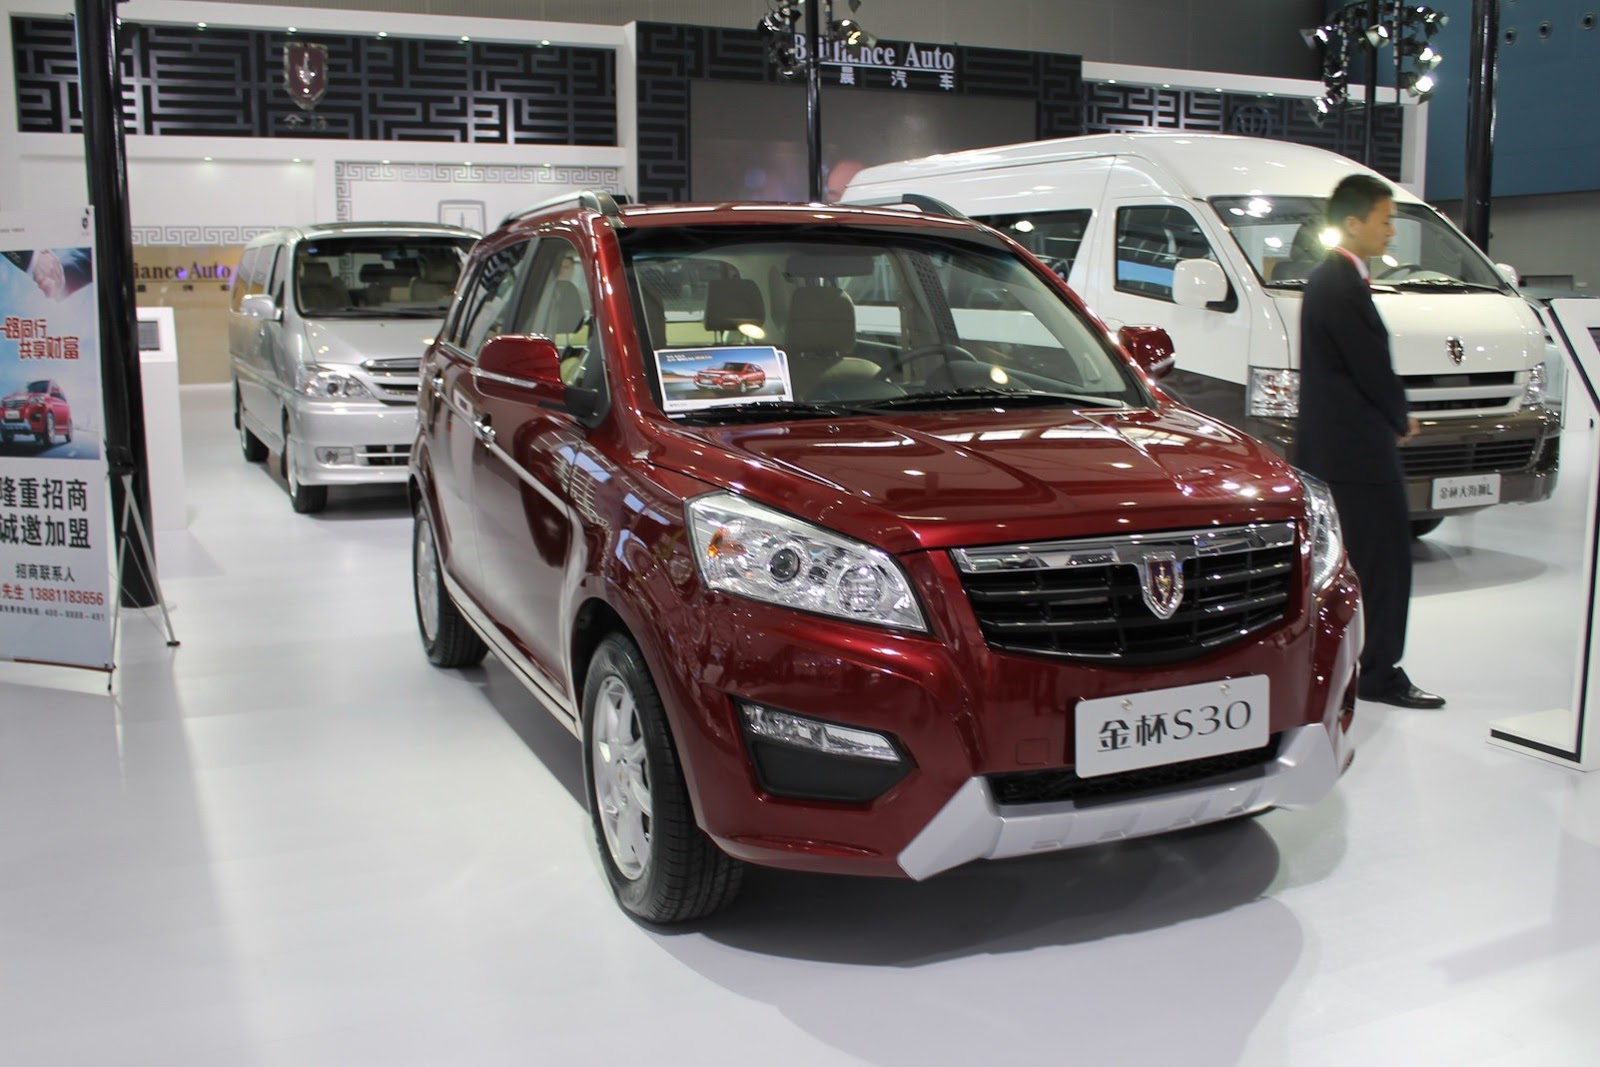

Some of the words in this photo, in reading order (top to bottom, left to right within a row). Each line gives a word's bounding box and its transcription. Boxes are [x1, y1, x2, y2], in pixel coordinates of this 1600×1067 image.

[904, 42, 955, 70] Auto
[189, 261, 231, 280] Auto
[19, 335, 79, 360] 共享财富
[0, 476, 88, 512] 隆重招商
[16, 563, 76, 583] 招商联系人
[29, 587, 104, 606] 13881183656
[1097, 700, 1252, 753] 金杯S30
